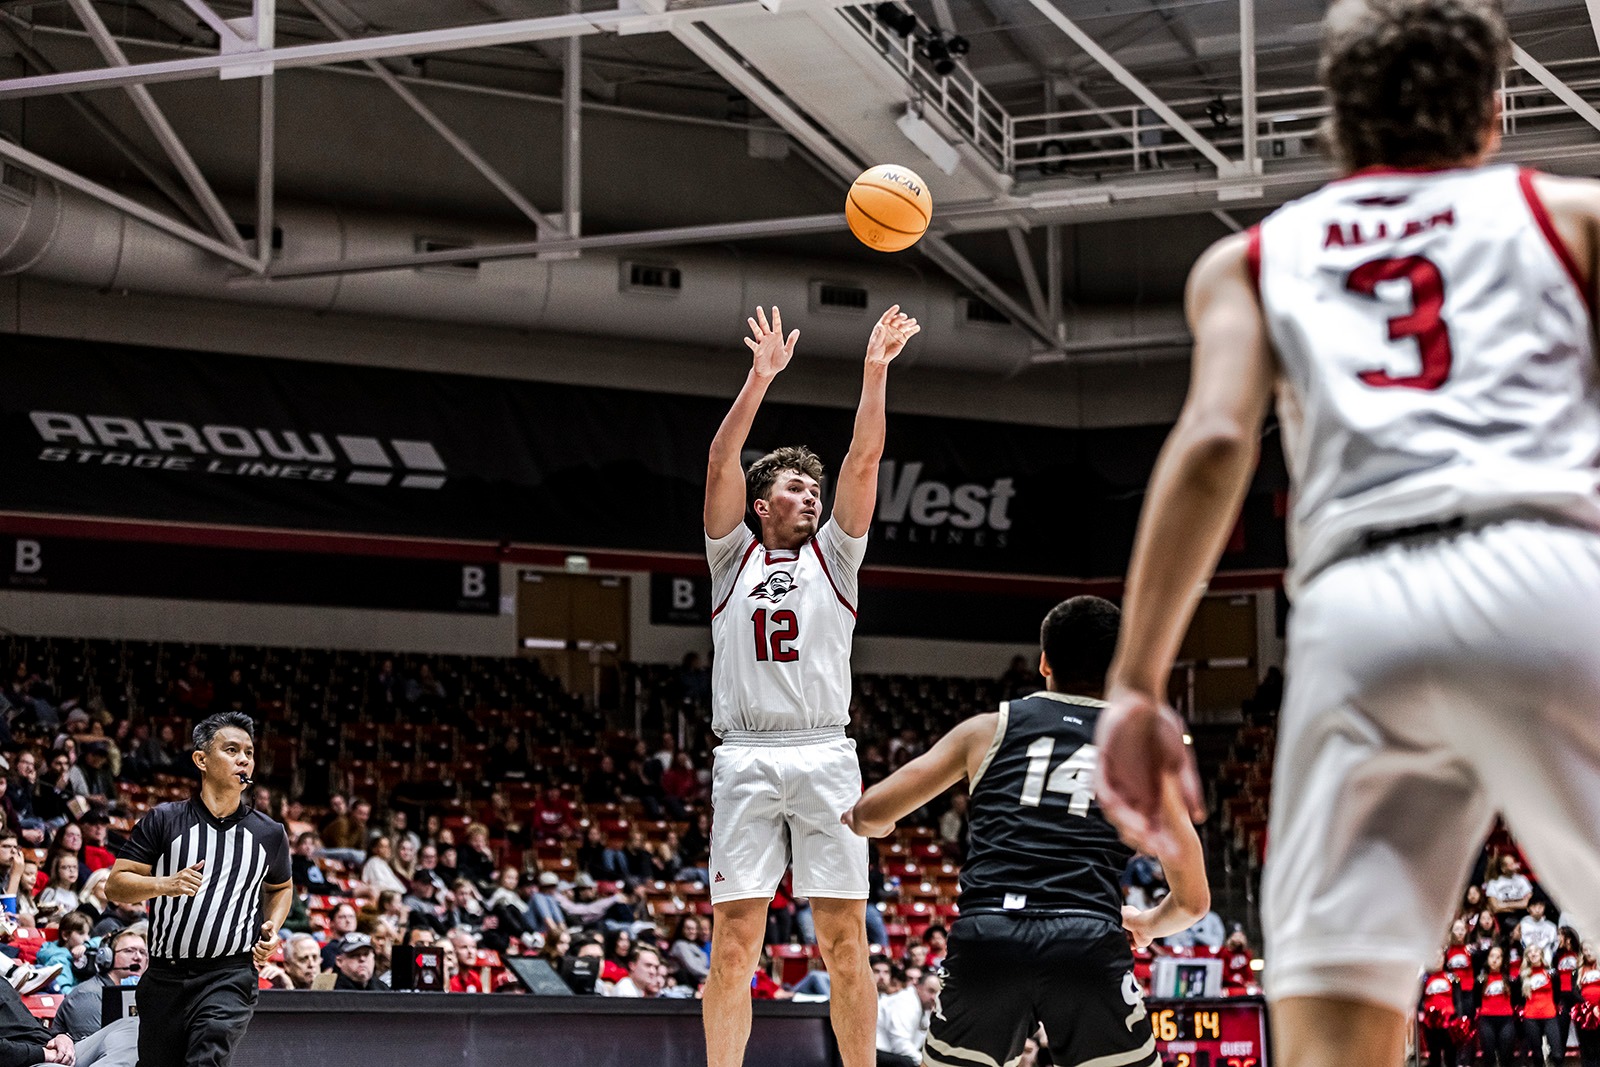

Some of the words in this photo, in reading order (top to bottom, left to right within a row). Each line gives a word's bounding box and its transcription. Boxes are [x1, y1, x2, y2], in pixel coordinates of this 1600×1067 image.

[1346, 254, 1451, 390] 3
[29, 410, 336, 463] ARROW
[38, 446, 196, 471] STAGE
[205, 459, 337, 482] LINES
[15, 539, 42, 574] B
[461, 564, 487, 599] B
[671, 577, 695, 610] B
[751, 607, 799, 662] 12
[1019, 736, 1098, 818] 14
[1220, 1040, 1253, 1057] GUEST
